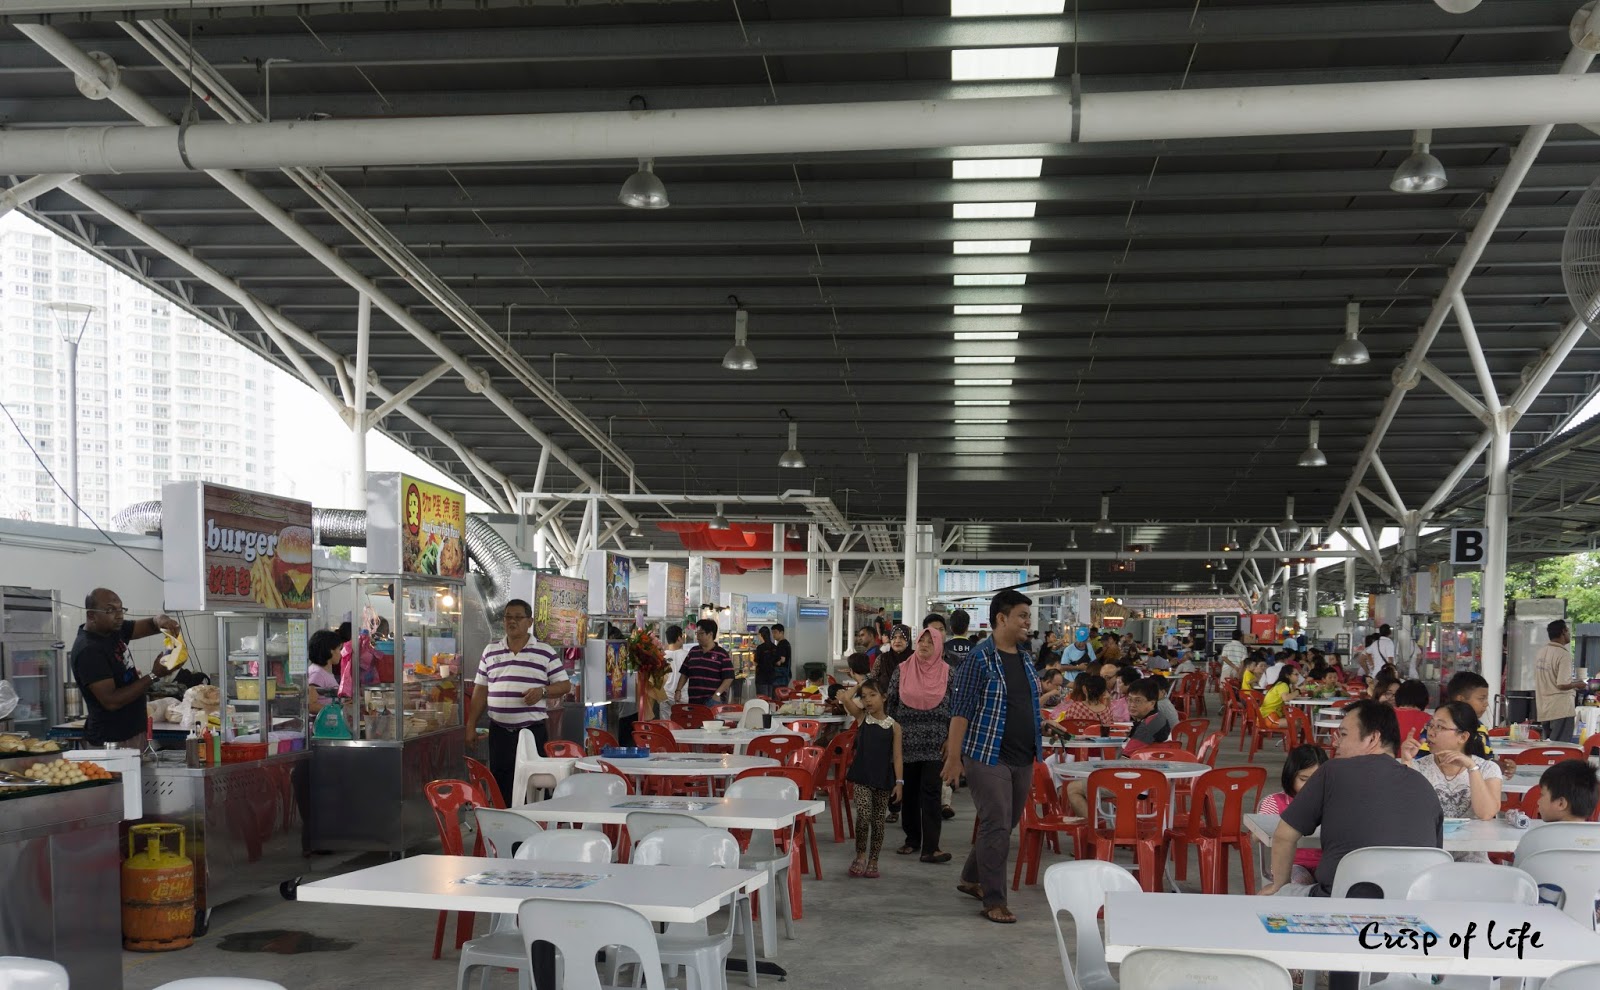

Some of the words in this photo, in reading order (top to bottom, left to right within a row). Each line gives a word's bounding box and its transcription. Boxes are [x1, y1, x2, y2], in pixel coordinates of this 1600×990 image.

[422, 491, 461, 521] 咖哩魚頭
[207, 518, 278, 562] burger
[1455, 530, 1484, 562] B
[1271, 601, 1282, 612] C
